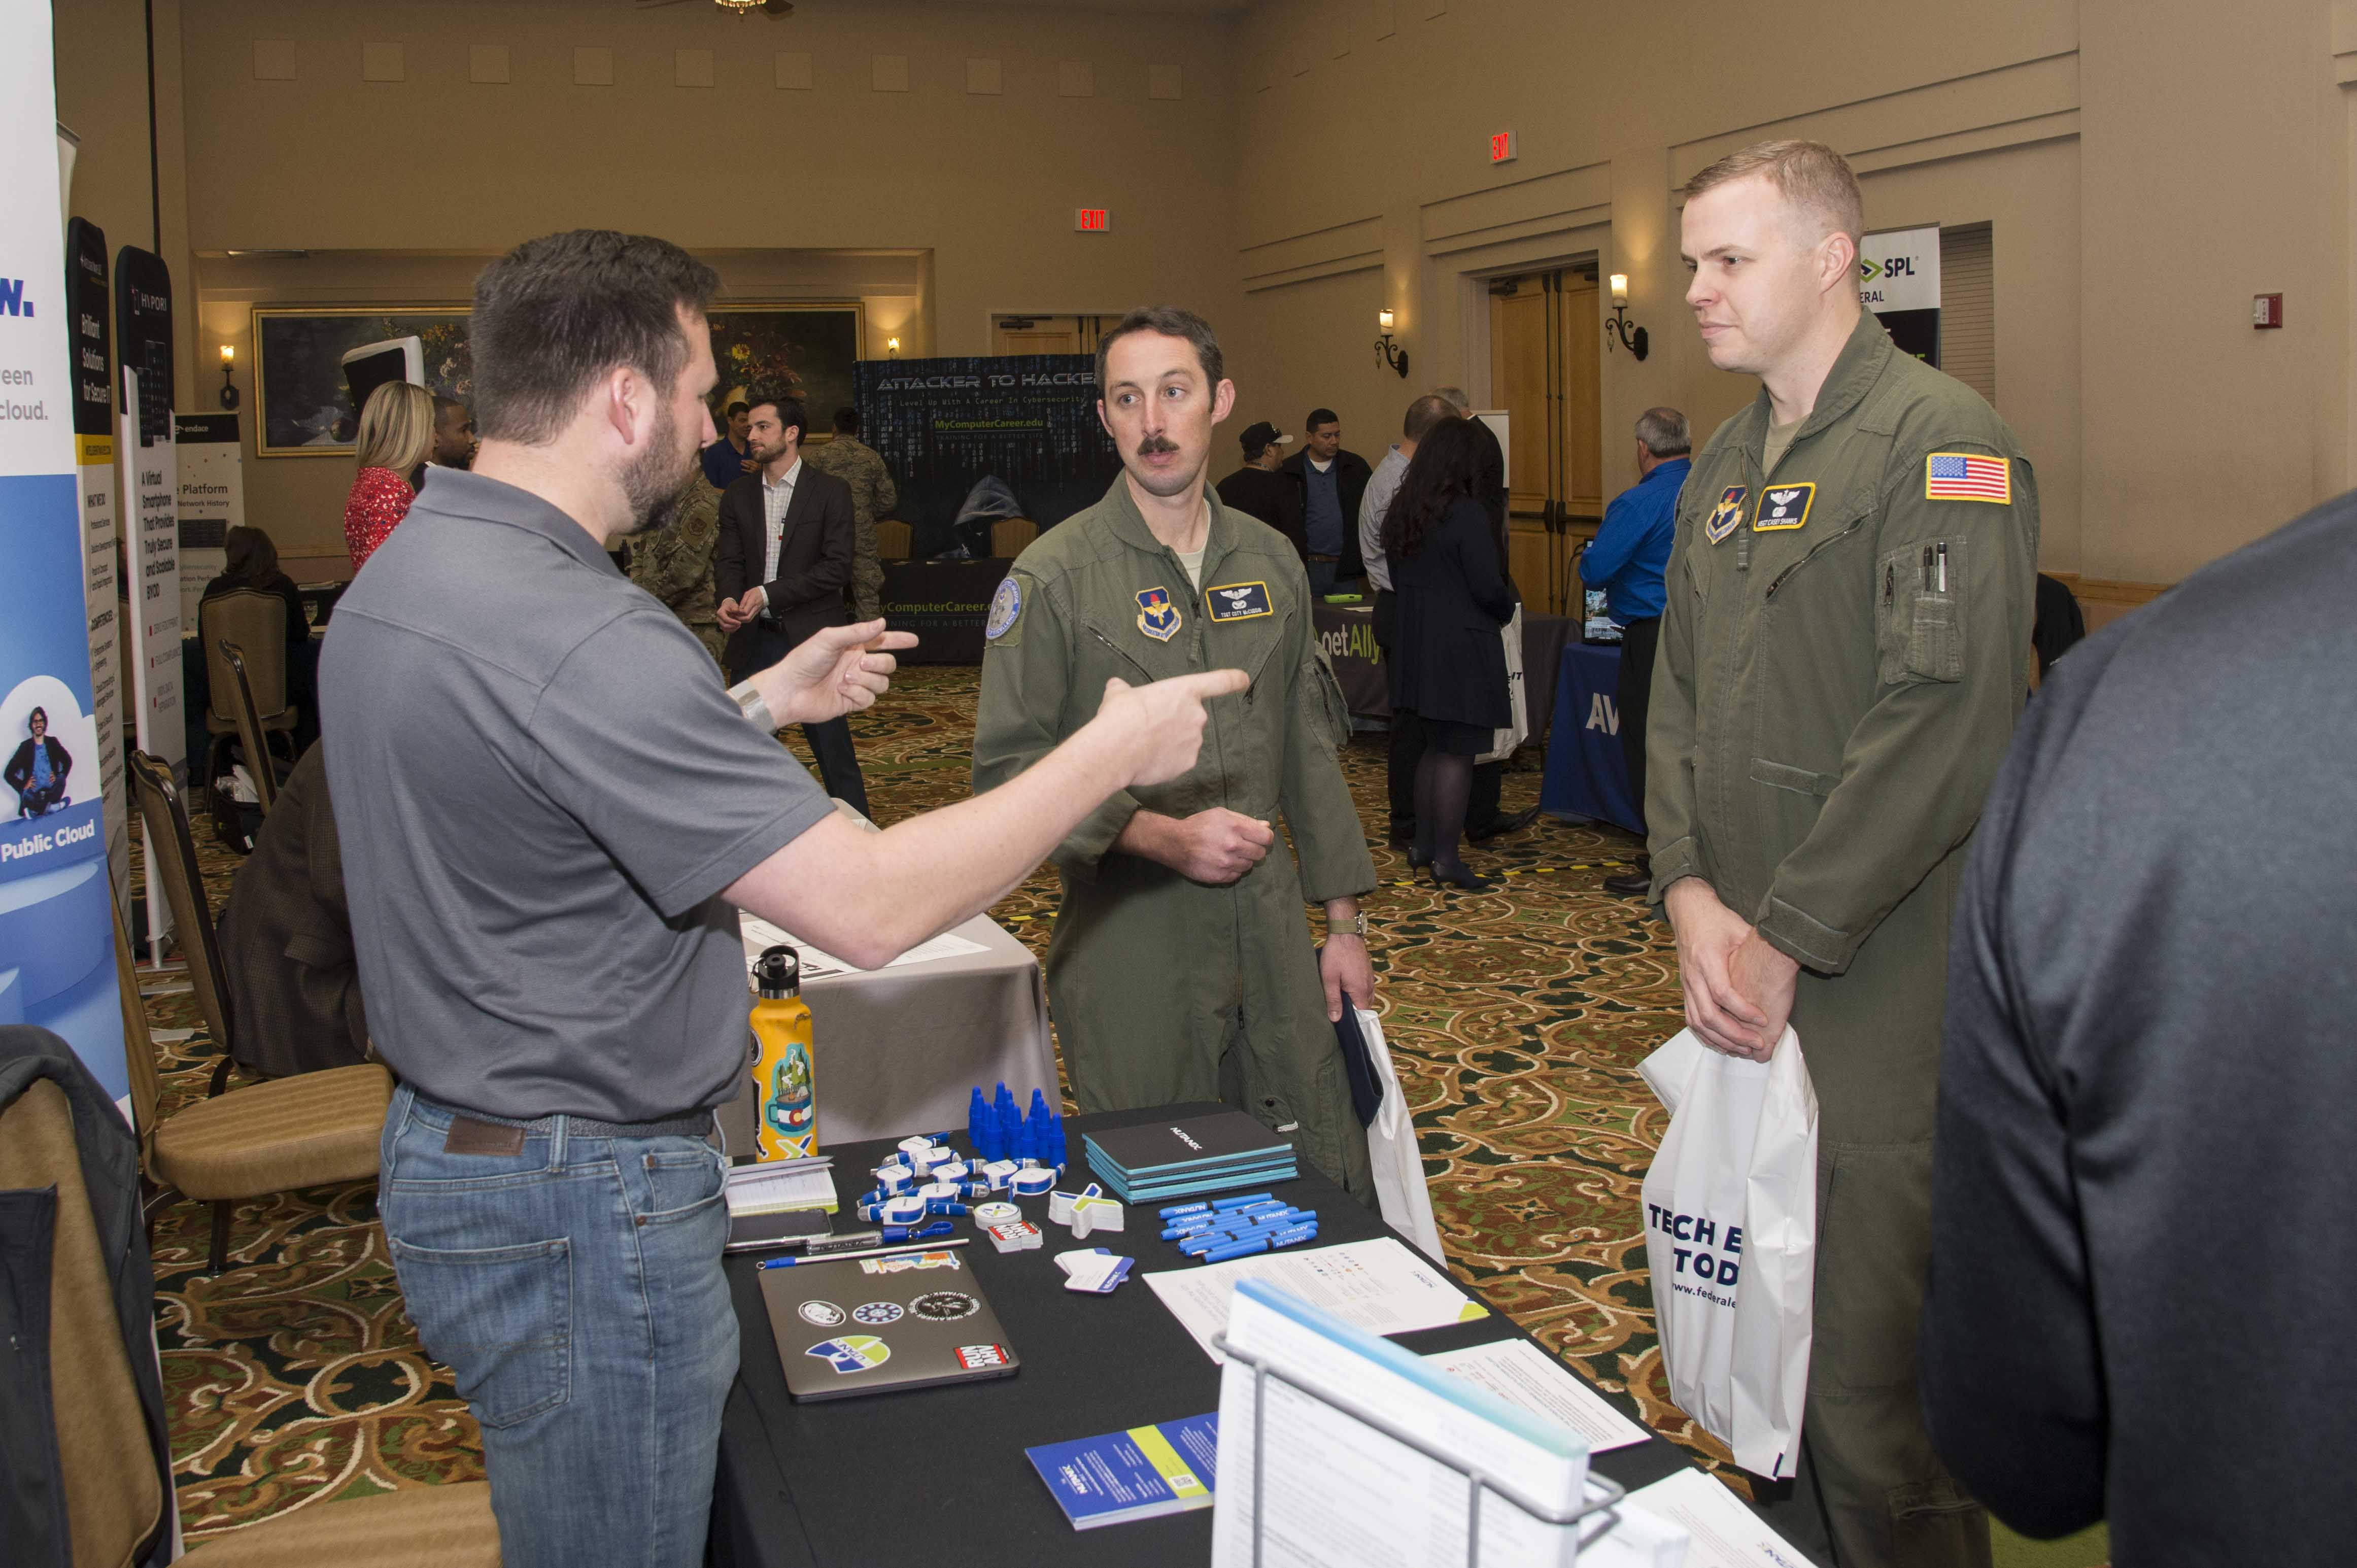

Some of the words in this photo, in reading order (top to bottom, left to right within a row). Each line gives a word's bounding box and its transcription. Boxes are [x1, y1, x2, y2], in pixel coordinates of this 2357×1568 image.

[1492, 133, 1508, 160] EXIT
[1081, 209, 1105, 229] EXIT
[1885, 257, 1915, 278] SPL
[83, 347, 104, 372] Solutions
[0, 369, 33, 386] een
[876, 376, 981, 390] ATTACKER
[988, 375, 1015, 387] TO
[1023, 396, 1084, 404] Cybersecurity
[935, 419, 1044, 430] MyComputerCareer.edu
[142, 471, 145, 487] A
[146, 470, 162, 486] Virtual
[183, 484, 228, 494] Platform
[142, 492, 172, 512] Smartphone
[207, 500, 230, 508] History
[144, 516, 155, 532] That
[155, 513, 175, 530] Provides
[144, 539, 157, 557] Truly
[157, 537, 173, 552] Secure
[146, 563, 155, 577] and
[156, 557, 175, 574] Scalable
[147, 584, 160, 600] BYOD
[1322, 624, 1380, 665] netAlly
[1, 834, 53, 862] Public
[55, 819, 95, 847] Cloud
[1170, 1126, 1203, 1151] NUTANIX
[1174, 1204, 1206, 1214] NUTANIX
[1649, 1203, 1716, 1246] TECH
[1276, 1234, 1307, 1247] NUTANIX
[1673, 1247, 1740, 1286] TOD
[1672, 1282, 1736, 1309] ww.federale
[960, 1345, 985, 1368] RUN
[976, 1345, 1002, 1364] AHV
